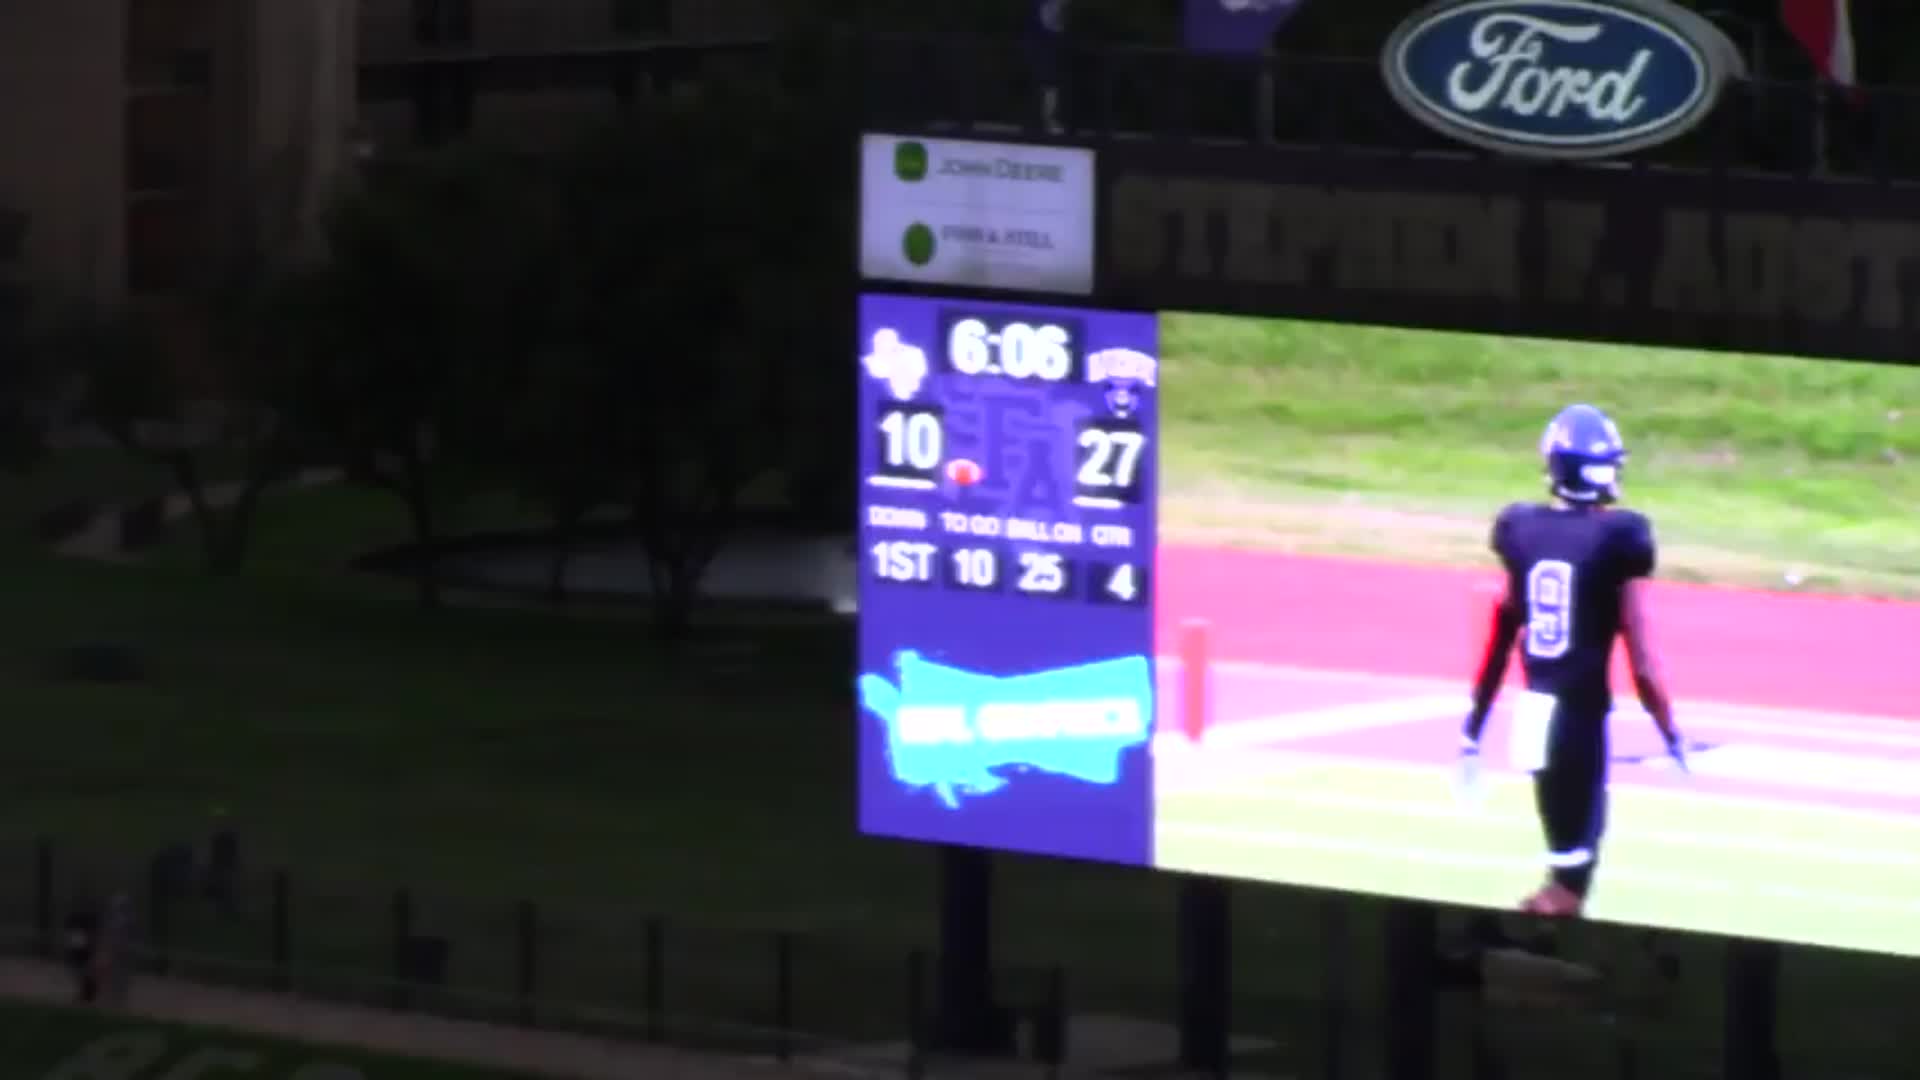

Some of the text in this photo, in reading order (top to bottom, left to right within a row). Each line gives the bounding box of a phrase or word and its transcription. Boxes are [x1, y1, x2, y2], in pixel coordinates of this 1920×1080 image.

[1447, 12, 1652, 122] Ford
[995, 159, 1065, 184] DEERE
[1651, 208, 1920, 330] AUST
[951, 319, 1070, 380] 6:06
[881, 411, 941, 469] 10
[1077, 428, 1144, 486] 27
[873, 541, 936, 580] 1ST
[954, 549, 994, 586] 10
[1019, 553, 1062, 591] 25
[1109, 563, 1134, 600] 4
